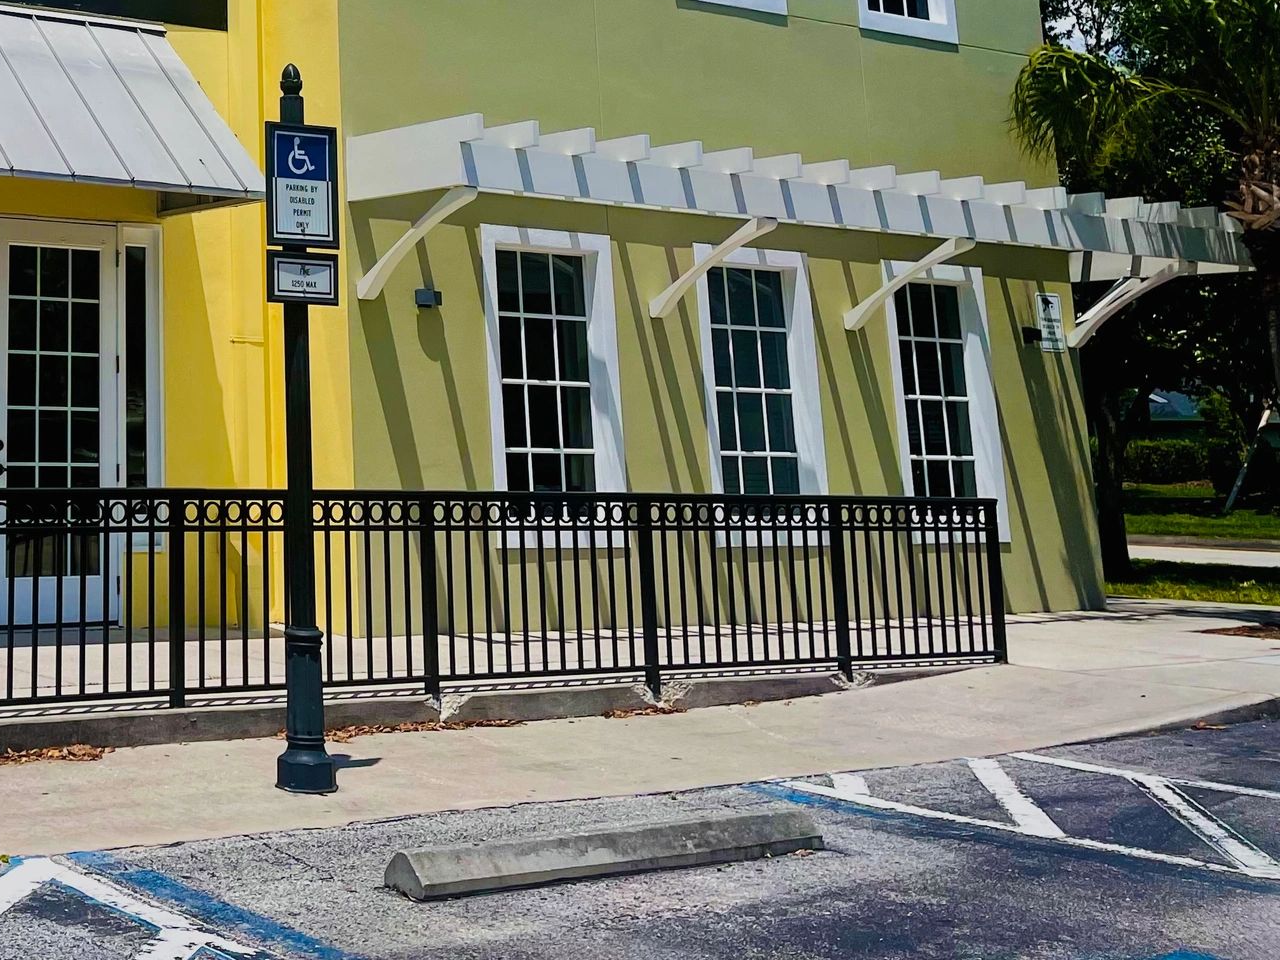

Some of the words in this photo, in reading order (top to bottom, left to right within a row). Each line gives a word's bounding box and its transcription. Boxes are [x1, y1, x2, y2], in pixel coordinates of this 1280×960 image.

[285, 183, 308, 193] PARKING
[311, 185, 318, 193] BY
[290, 196, 315, 205] DISABLED
[293, 208, 311, 217] PERMIT
[296, 221, 309, 229] ONLY
[306, 280, 317, 288] MAX
